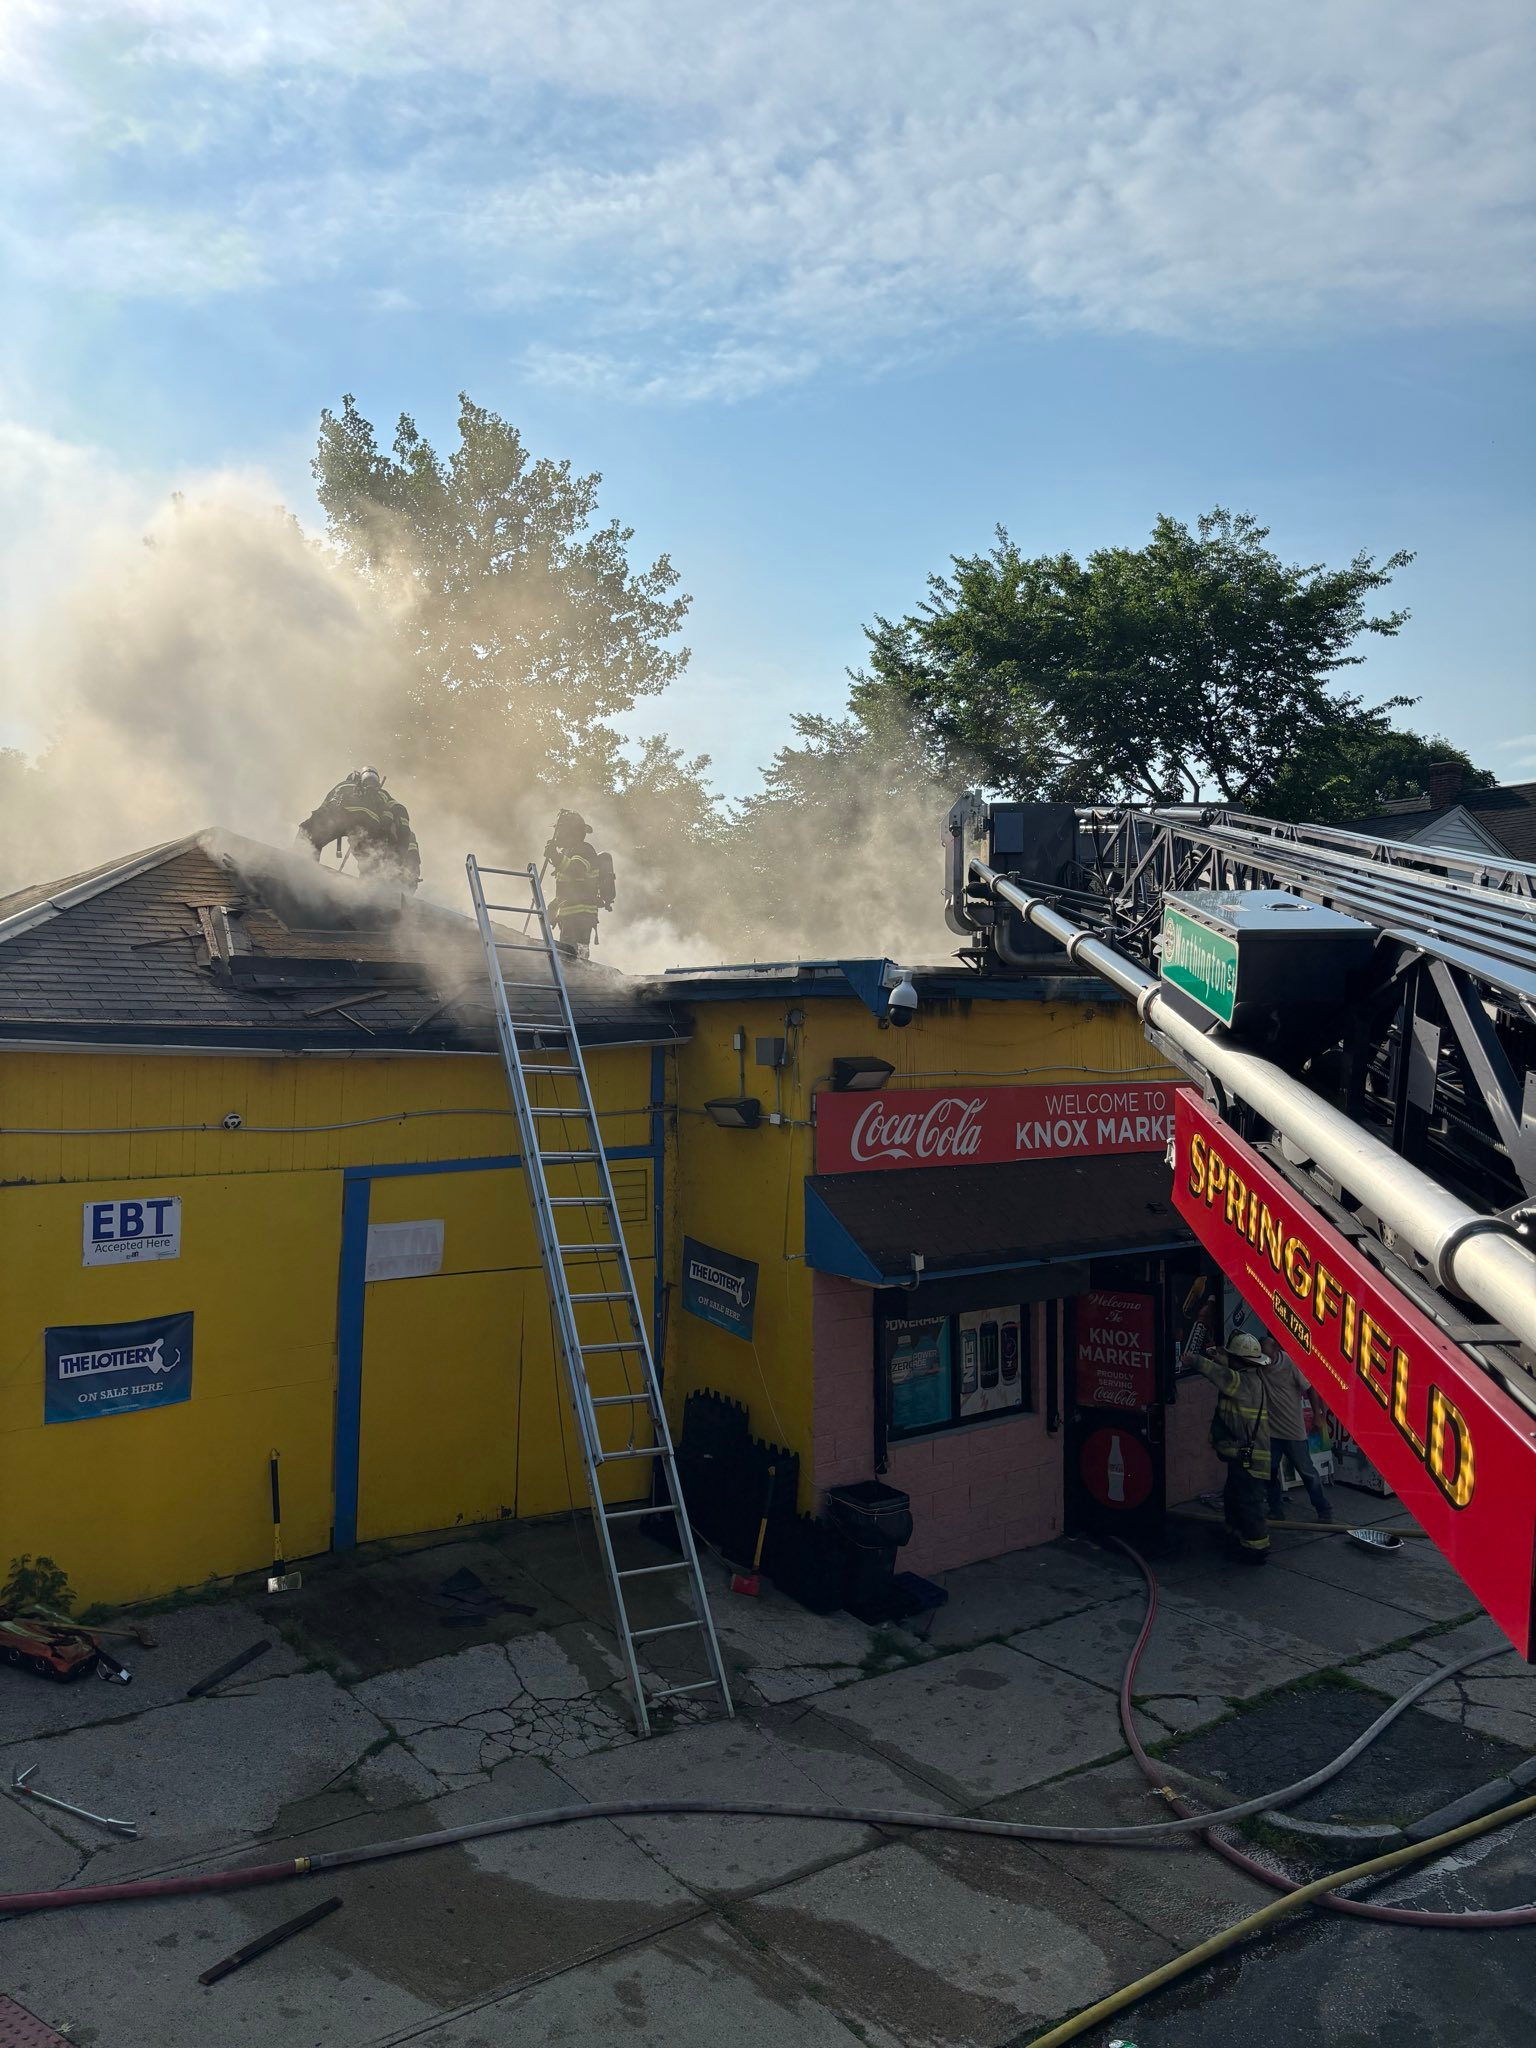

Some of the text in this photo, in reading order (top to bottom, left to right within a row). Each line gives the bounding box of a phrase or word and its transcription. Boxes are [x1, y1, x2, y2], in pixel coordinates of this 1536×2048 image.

[1175, 923, 1227, 999] Worthington
[1045, 1091, 1166, 1116] WELCOME TO
[850, 1097, 988, 1162] Coca-Cola
[1015, 1115, 1176, 1151] KNOX MARKE
[92, 1200, 173, 1240] EBT
[95, 1239, 171, 1253] Accepted Here
[698, 1296, 709, 1306] ON
[709, 1302, 725, 1313] SALE
[724, 1307, 741, 1321] HERE
[1088, 1294, 1141, 1310] Welcome
[1187, 1132, 1475, 1511] SPRINGFIELD
[1274, 1294, 1310, 1348] Est. 1794
[1089, 1327, 1140, 1349] KNOX
[963, 1340, 975, 1383] NOS
[1079, 1344, 1153, 1369] MARKET
[1096, 1369, 1135, 1381] PROUDLY
[1098, 1379, 1134, 1390] SERVING
[78, 1382, 164, 1403] ON SALE HERE
